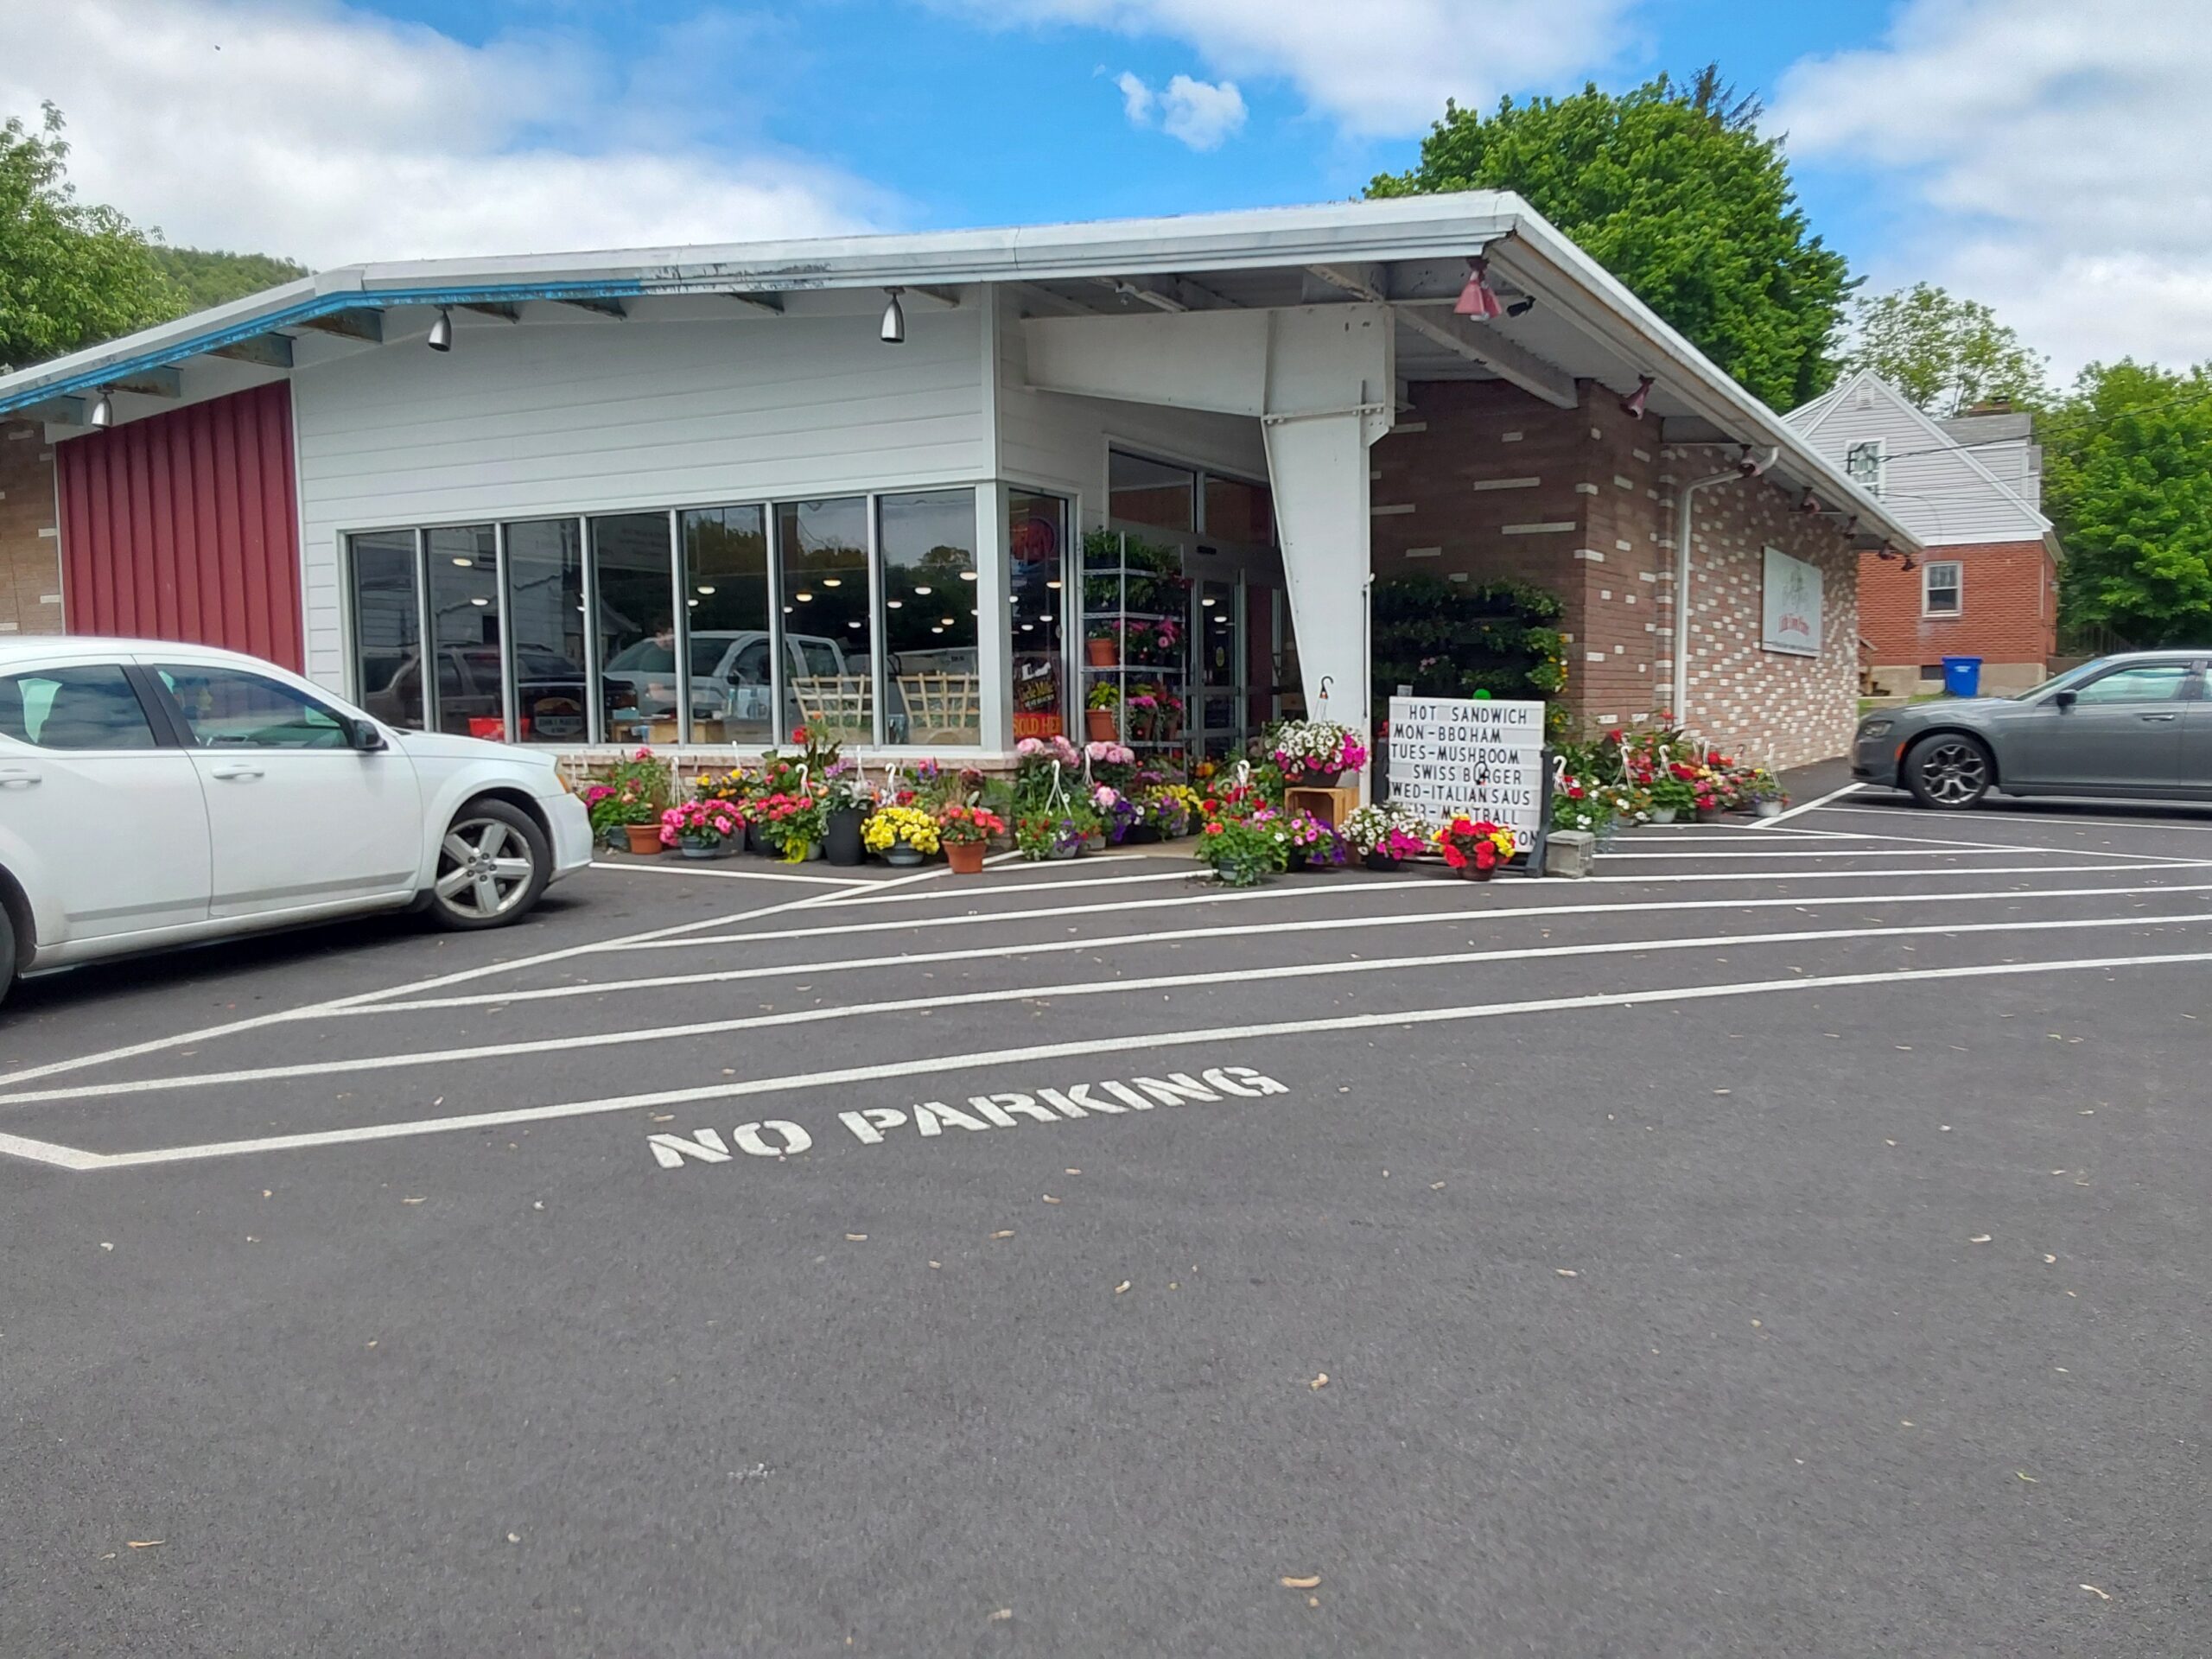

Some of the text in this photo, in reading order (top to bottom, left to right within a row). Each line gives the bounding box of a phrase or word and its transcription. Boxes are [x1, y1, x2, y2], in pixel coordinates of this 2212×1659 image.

[1409, 705, 1528, 725] HOT SANDWICH
[1014, 717, 1039, 735] SOLD
[1413, 764, 1456, 781] SWISS
[1491, 790, 1530, 805] SAUS
[646, 1066, 1290, 1168] NO PARKING
